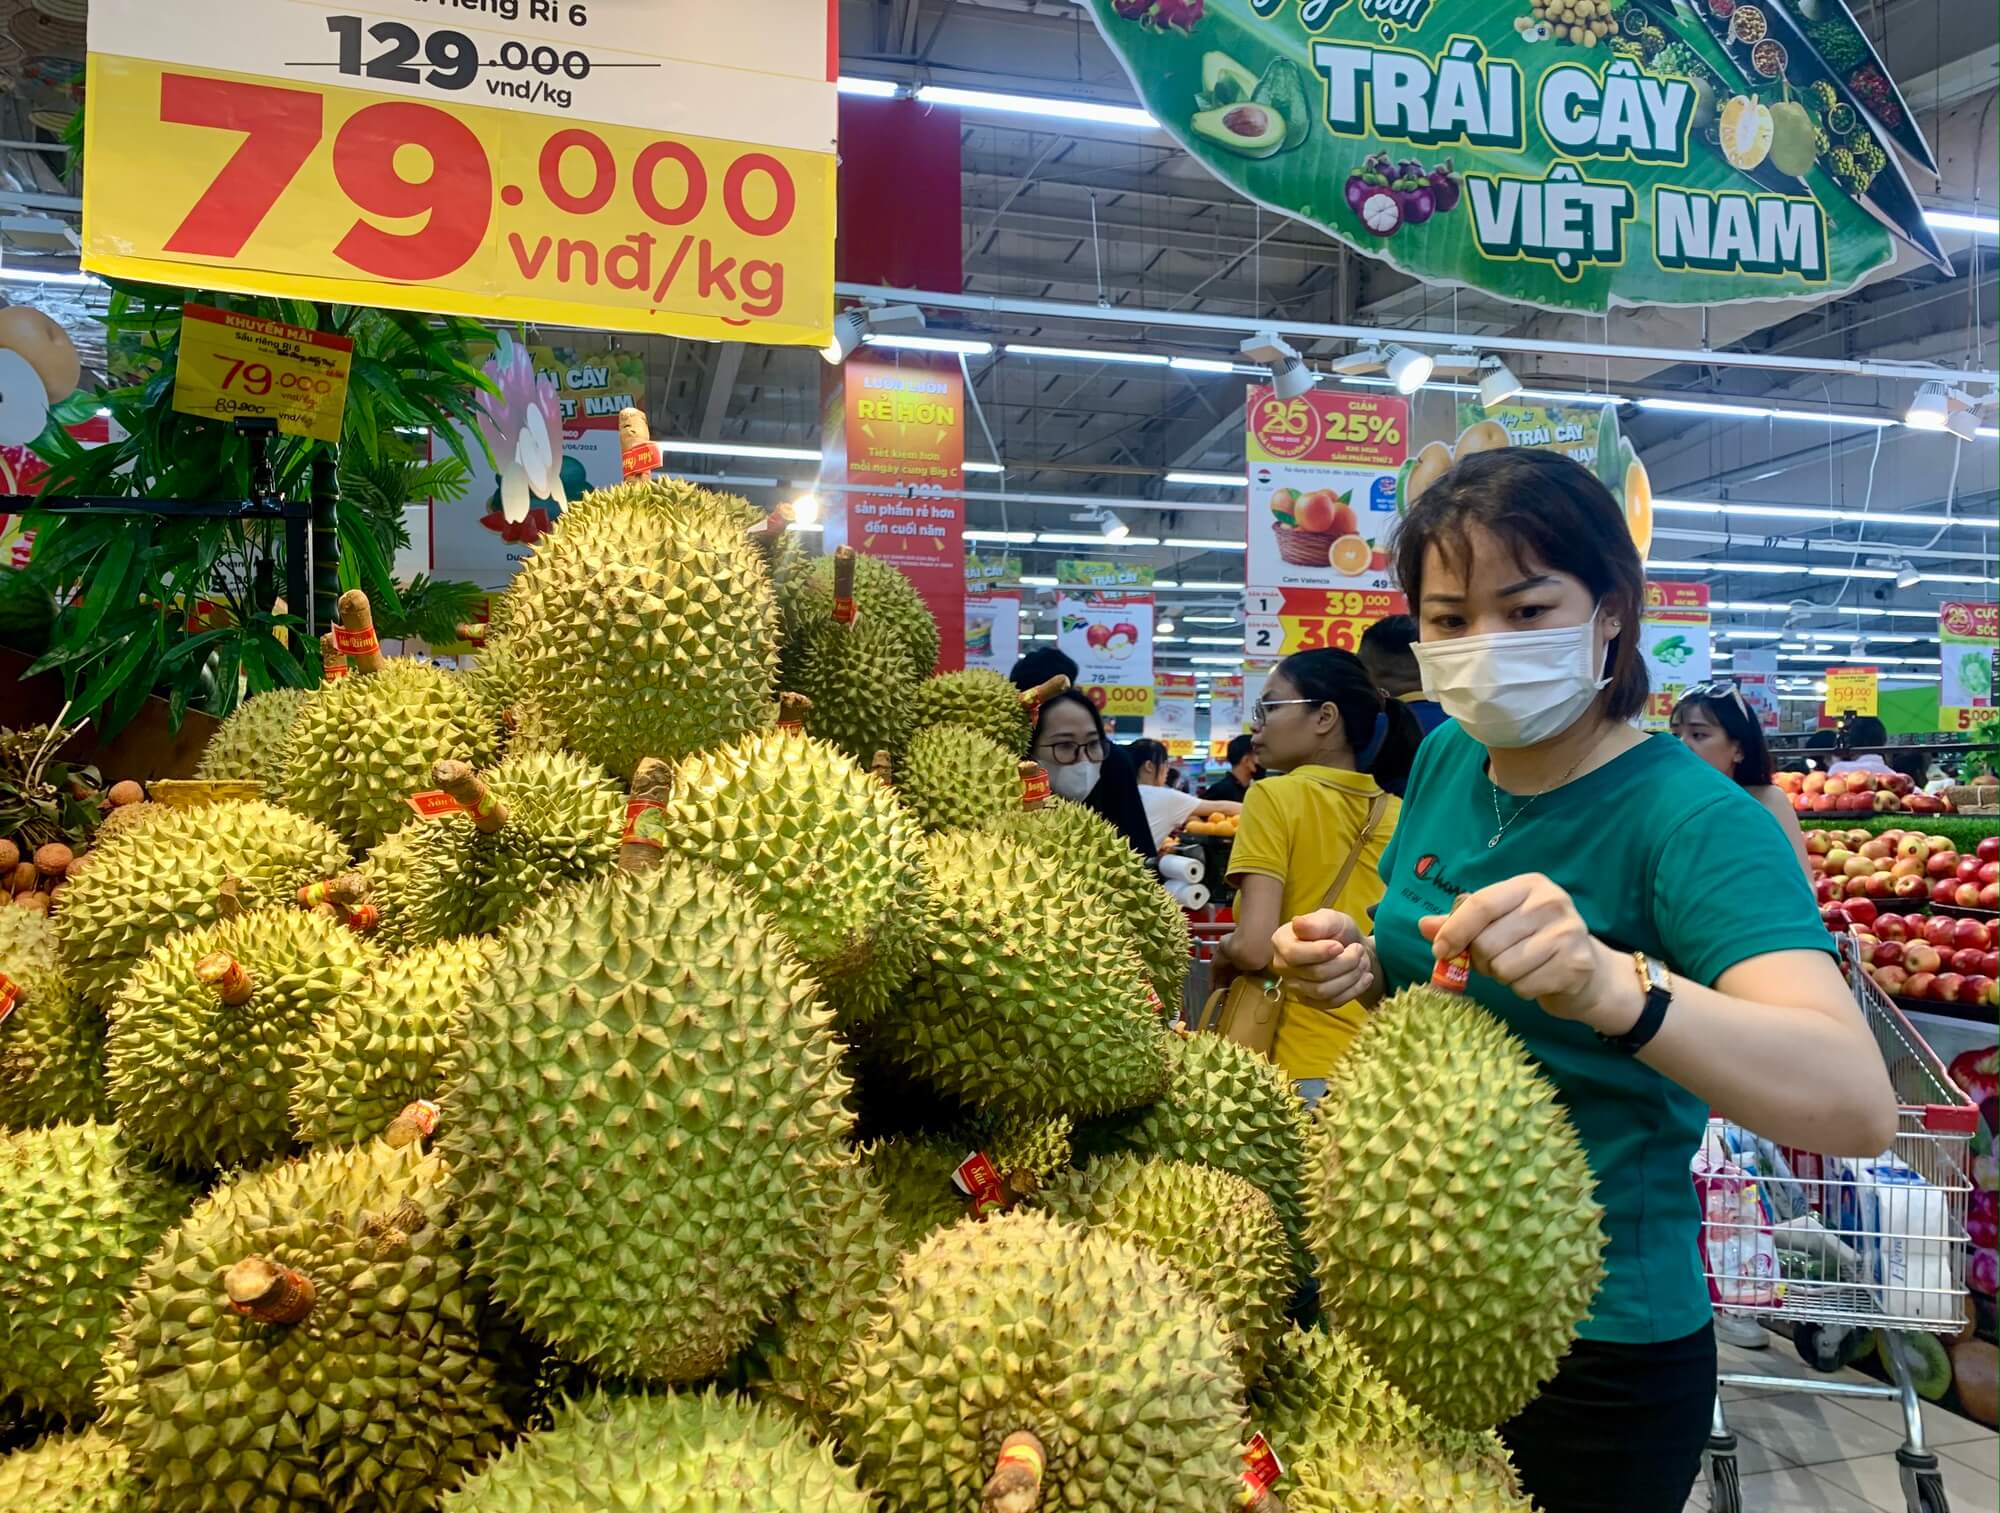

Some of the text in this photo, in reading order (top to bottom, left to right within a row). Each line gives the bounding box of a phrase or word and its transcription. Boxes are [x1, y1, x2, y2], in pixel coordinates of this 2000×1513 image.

[529, 1, 559, 23] Ri
[568, 4, 588, 27] 6
[326, 15, 591, 91] 129.000
[486, 79, 572, 108] vnd/kg
[1314, 43, 1690, 152] TRÁI CÂY
[159, 72, 797, 281] 79.000
[1466, 164, 1819, 270] VIỆT NAM
[508, 231, 785, 317] vnđ/kg
[213, 353, 332, 395] 79.000
[566, 364, 609, 390] CÂY
[584, 394, 636, 416] NAM
[859, 393, 955, 426] RẺ HƠN
[1325, 411, 1400, 445] 25%
[1511, 422, 1584, 446] TRÁI CÂY
[855, 500, 876, 514] sản
[879, 500, 913, 517] phẩm
[931, 506, 955, 518] hơn
[864, 519, 946, 537] đến cuối năm
[1259, 599, 1267, 611] 1
[1325, 591, 1391, 615] 39.000
[1256, 630, 1270, 646] 2
